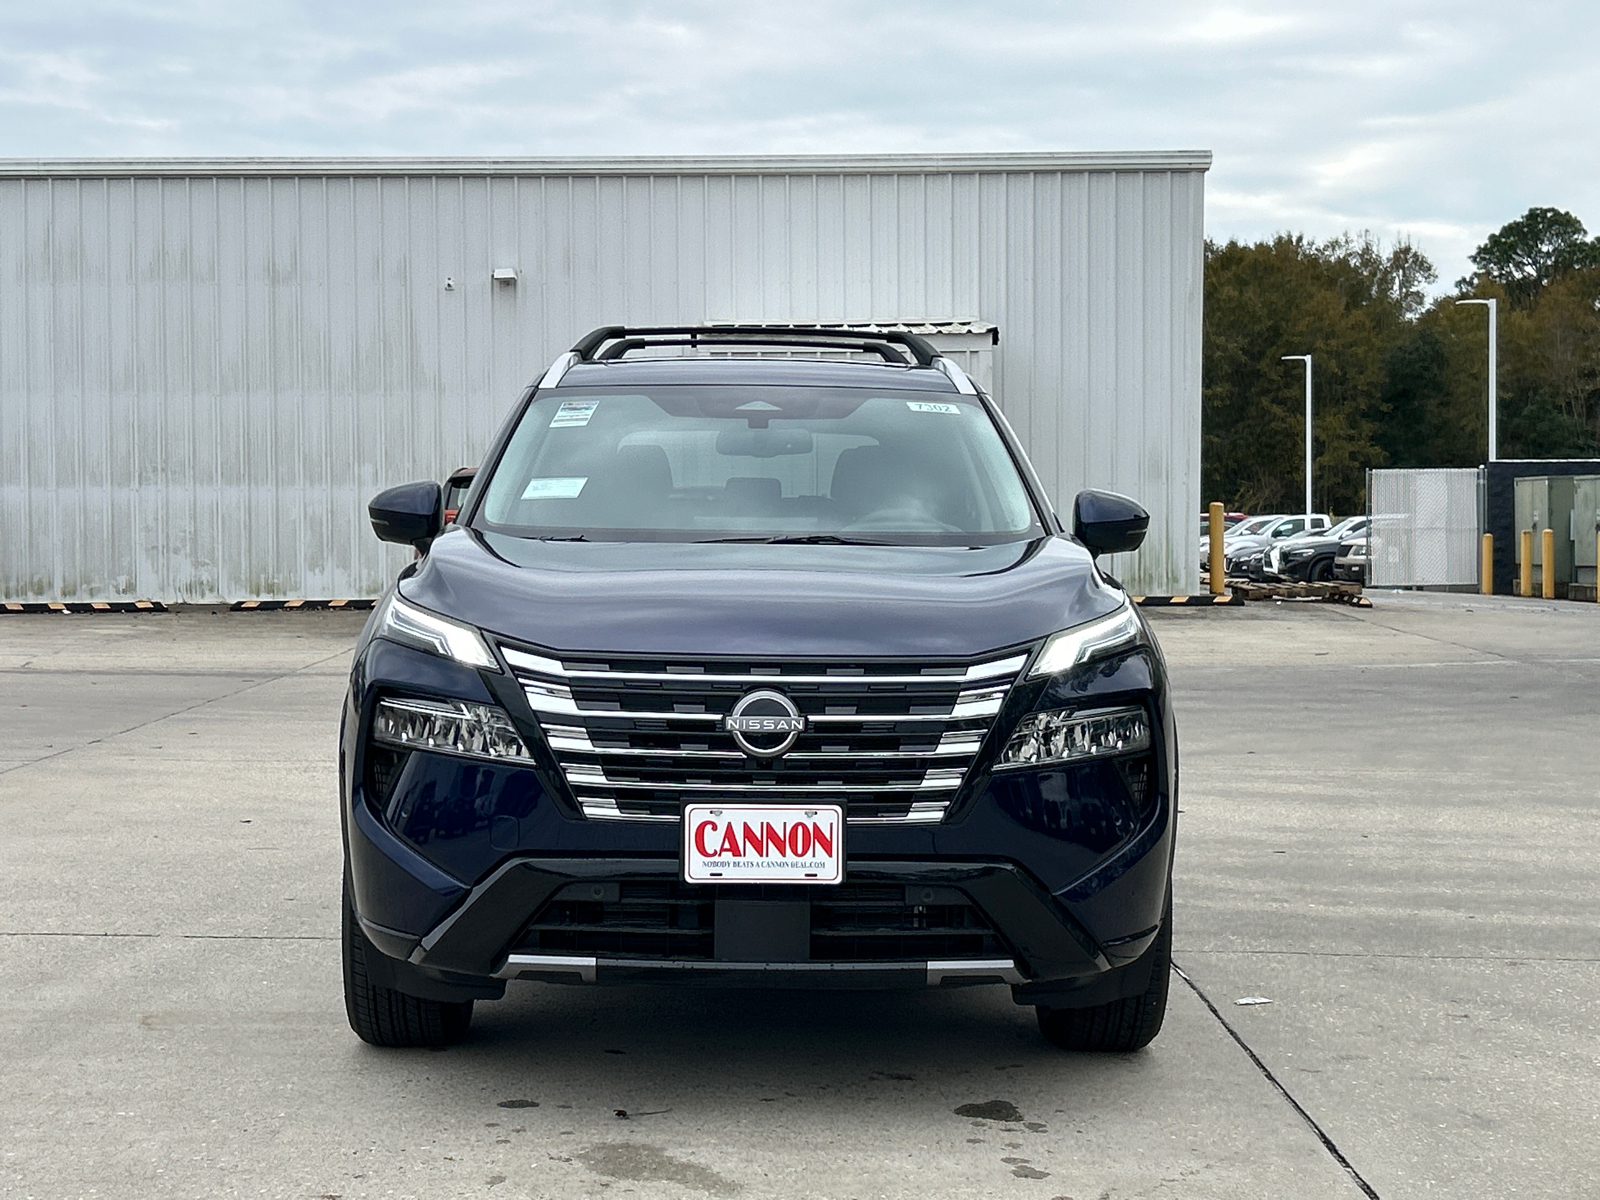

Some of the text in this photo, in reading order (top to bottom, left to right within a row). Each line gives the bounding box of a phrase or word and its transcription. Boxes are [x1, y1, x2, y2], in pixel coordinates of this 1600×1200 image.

[914, 403, 953, 413] 7302
[727, 719, 803, 730] NISSAN
[694, 820, 834, 858] CANNON
[702, 860, 731, 868] NOBODY
[732, 860, 754, 868] BEATS
[761, 860, 789, 868] CANNON
[790, 860, 825, 869] DEAL.COM
